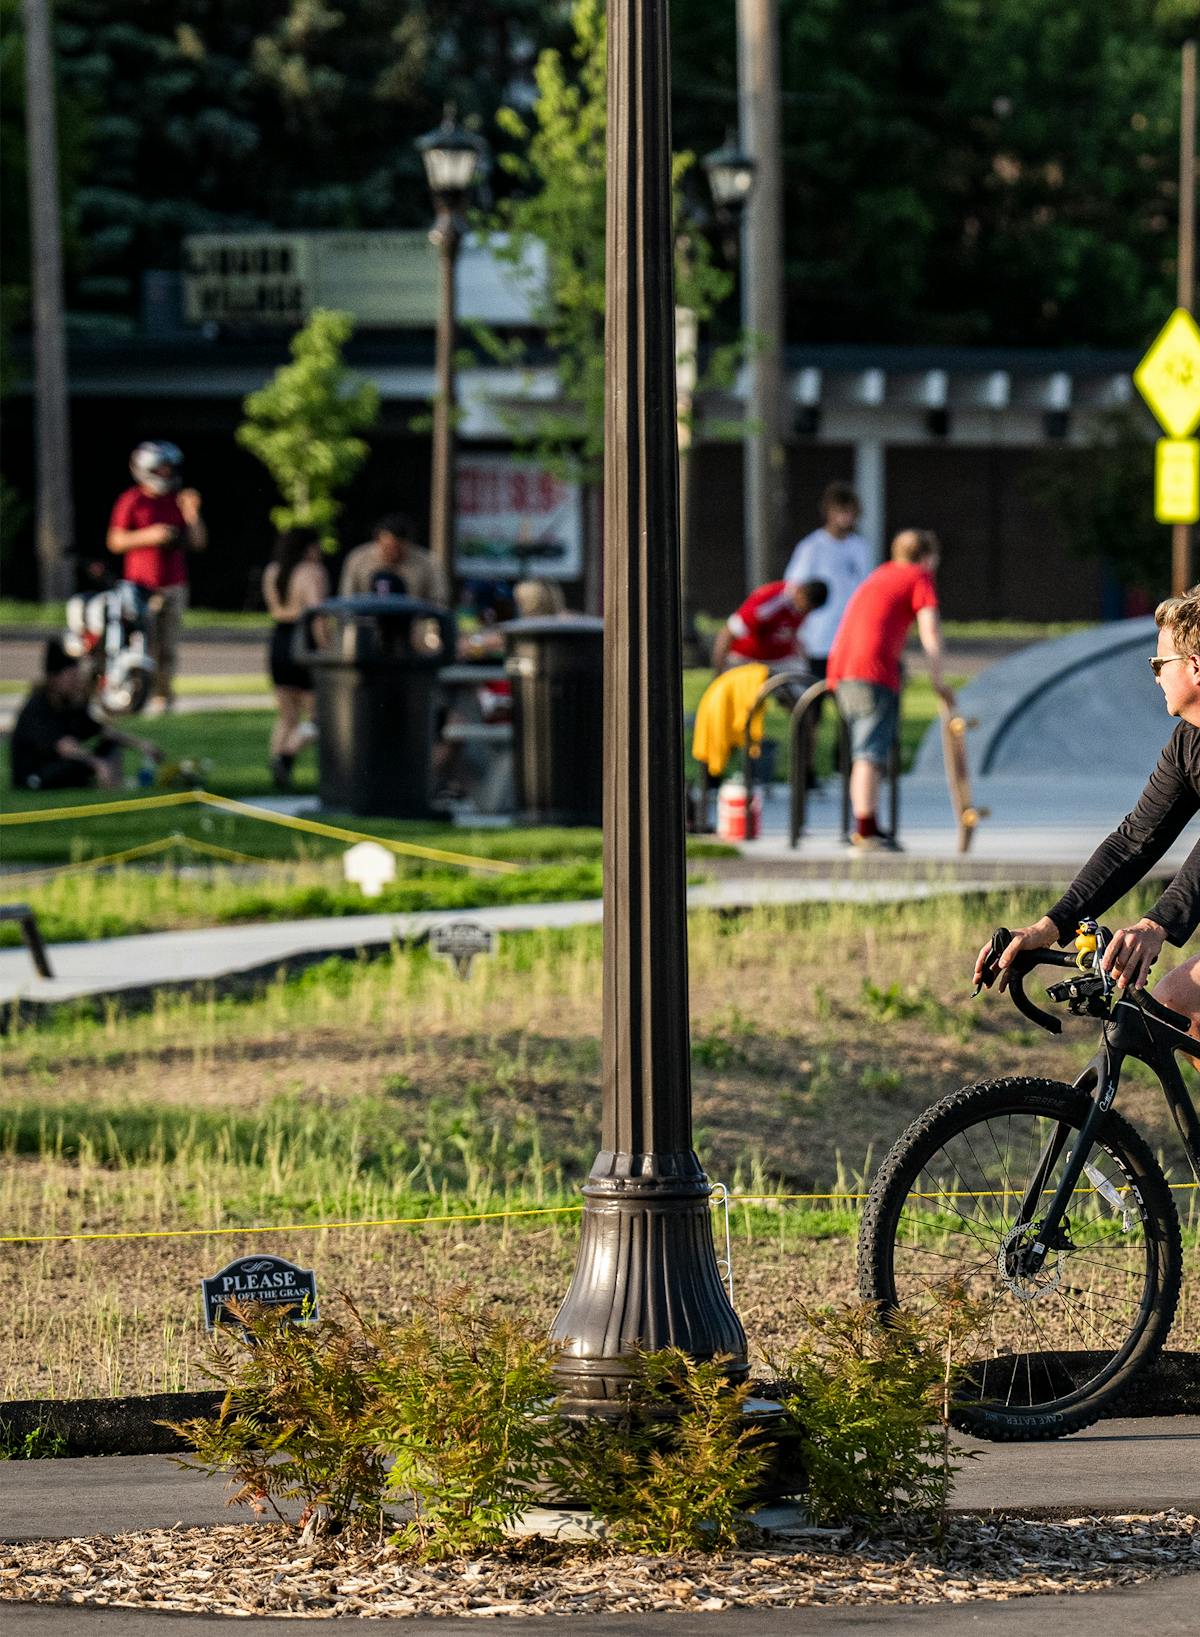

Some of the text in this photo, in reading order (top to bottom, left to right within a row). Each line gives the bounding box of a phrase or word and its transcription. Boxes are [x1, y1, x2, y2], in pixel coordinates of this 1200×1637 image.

[222, 1271, 296, 1292] PLEASE
[238, 1291, 257, 1301] OFF
[259, 1290, 277, 1299] THE
[279, 1287, 310, 1297] GRASS
